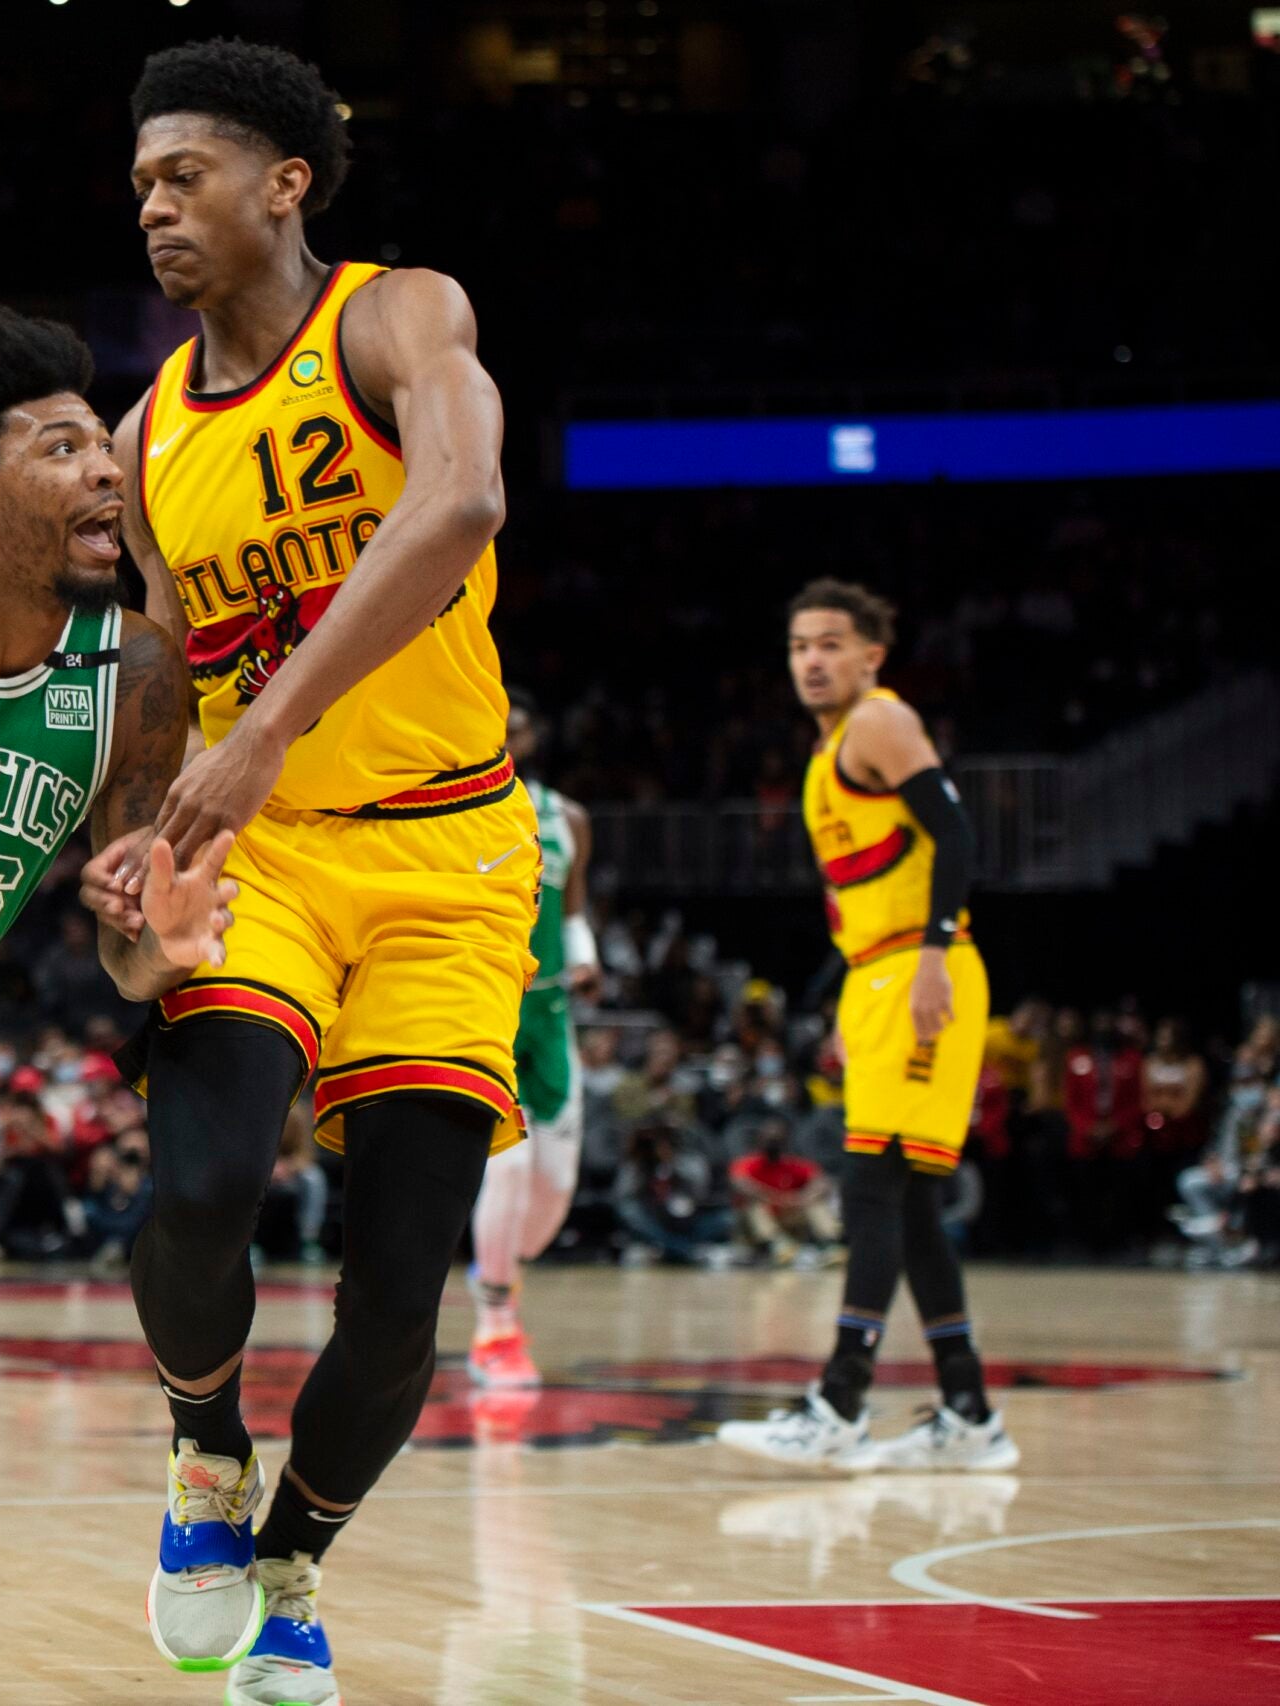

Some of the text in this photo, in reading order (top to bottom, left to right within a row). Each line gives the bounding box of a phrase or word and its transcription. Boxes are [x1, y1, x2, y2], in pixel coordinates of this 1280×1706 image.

[249, 412, 364, 522] 12
[65, 653, 82, 668] 24
[47, 689, 89, 710] VISTA
[49, 712, 75, 725] PRINT
